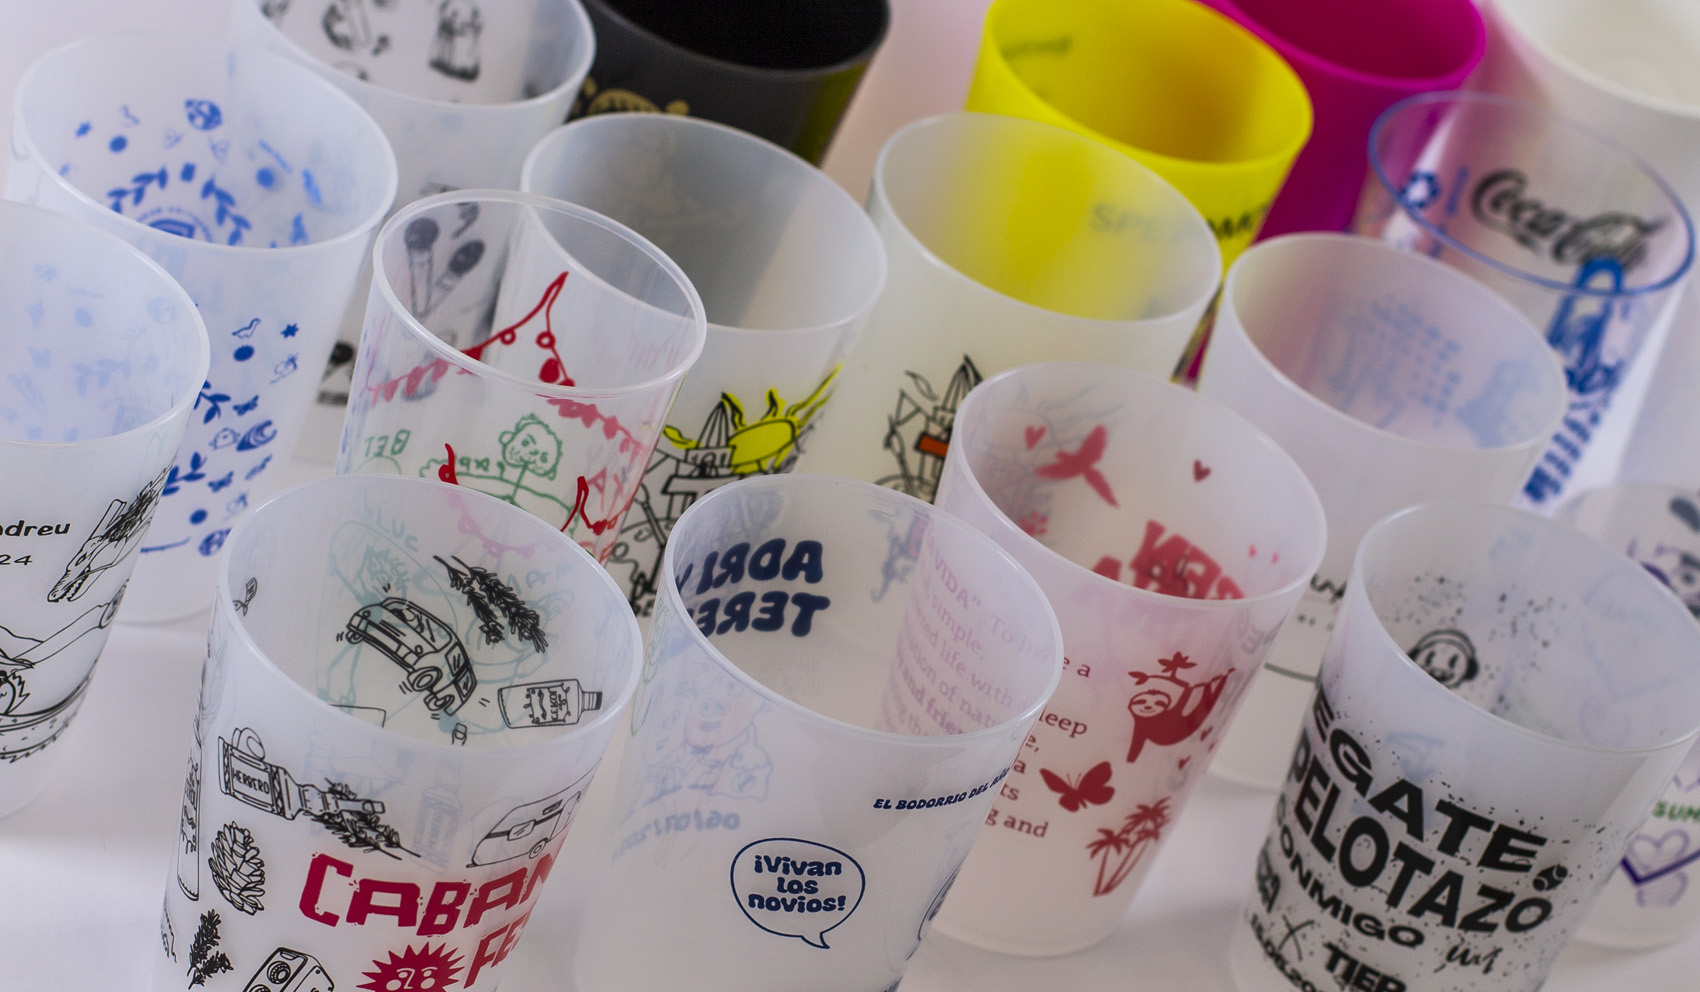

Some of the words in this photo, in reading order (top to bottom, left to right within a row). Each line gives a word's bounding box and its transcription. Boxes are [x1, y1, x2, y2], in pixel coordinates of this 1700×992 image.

[873, 798, 892, 810] EL
[895, 791, 968, 810] BODORRIO
[968, 782, 989, 799] DEL
[1003, 814, 1049, 838] and
[777, 877, 819, 895] los
[748, 893, 847, 913] novios!
